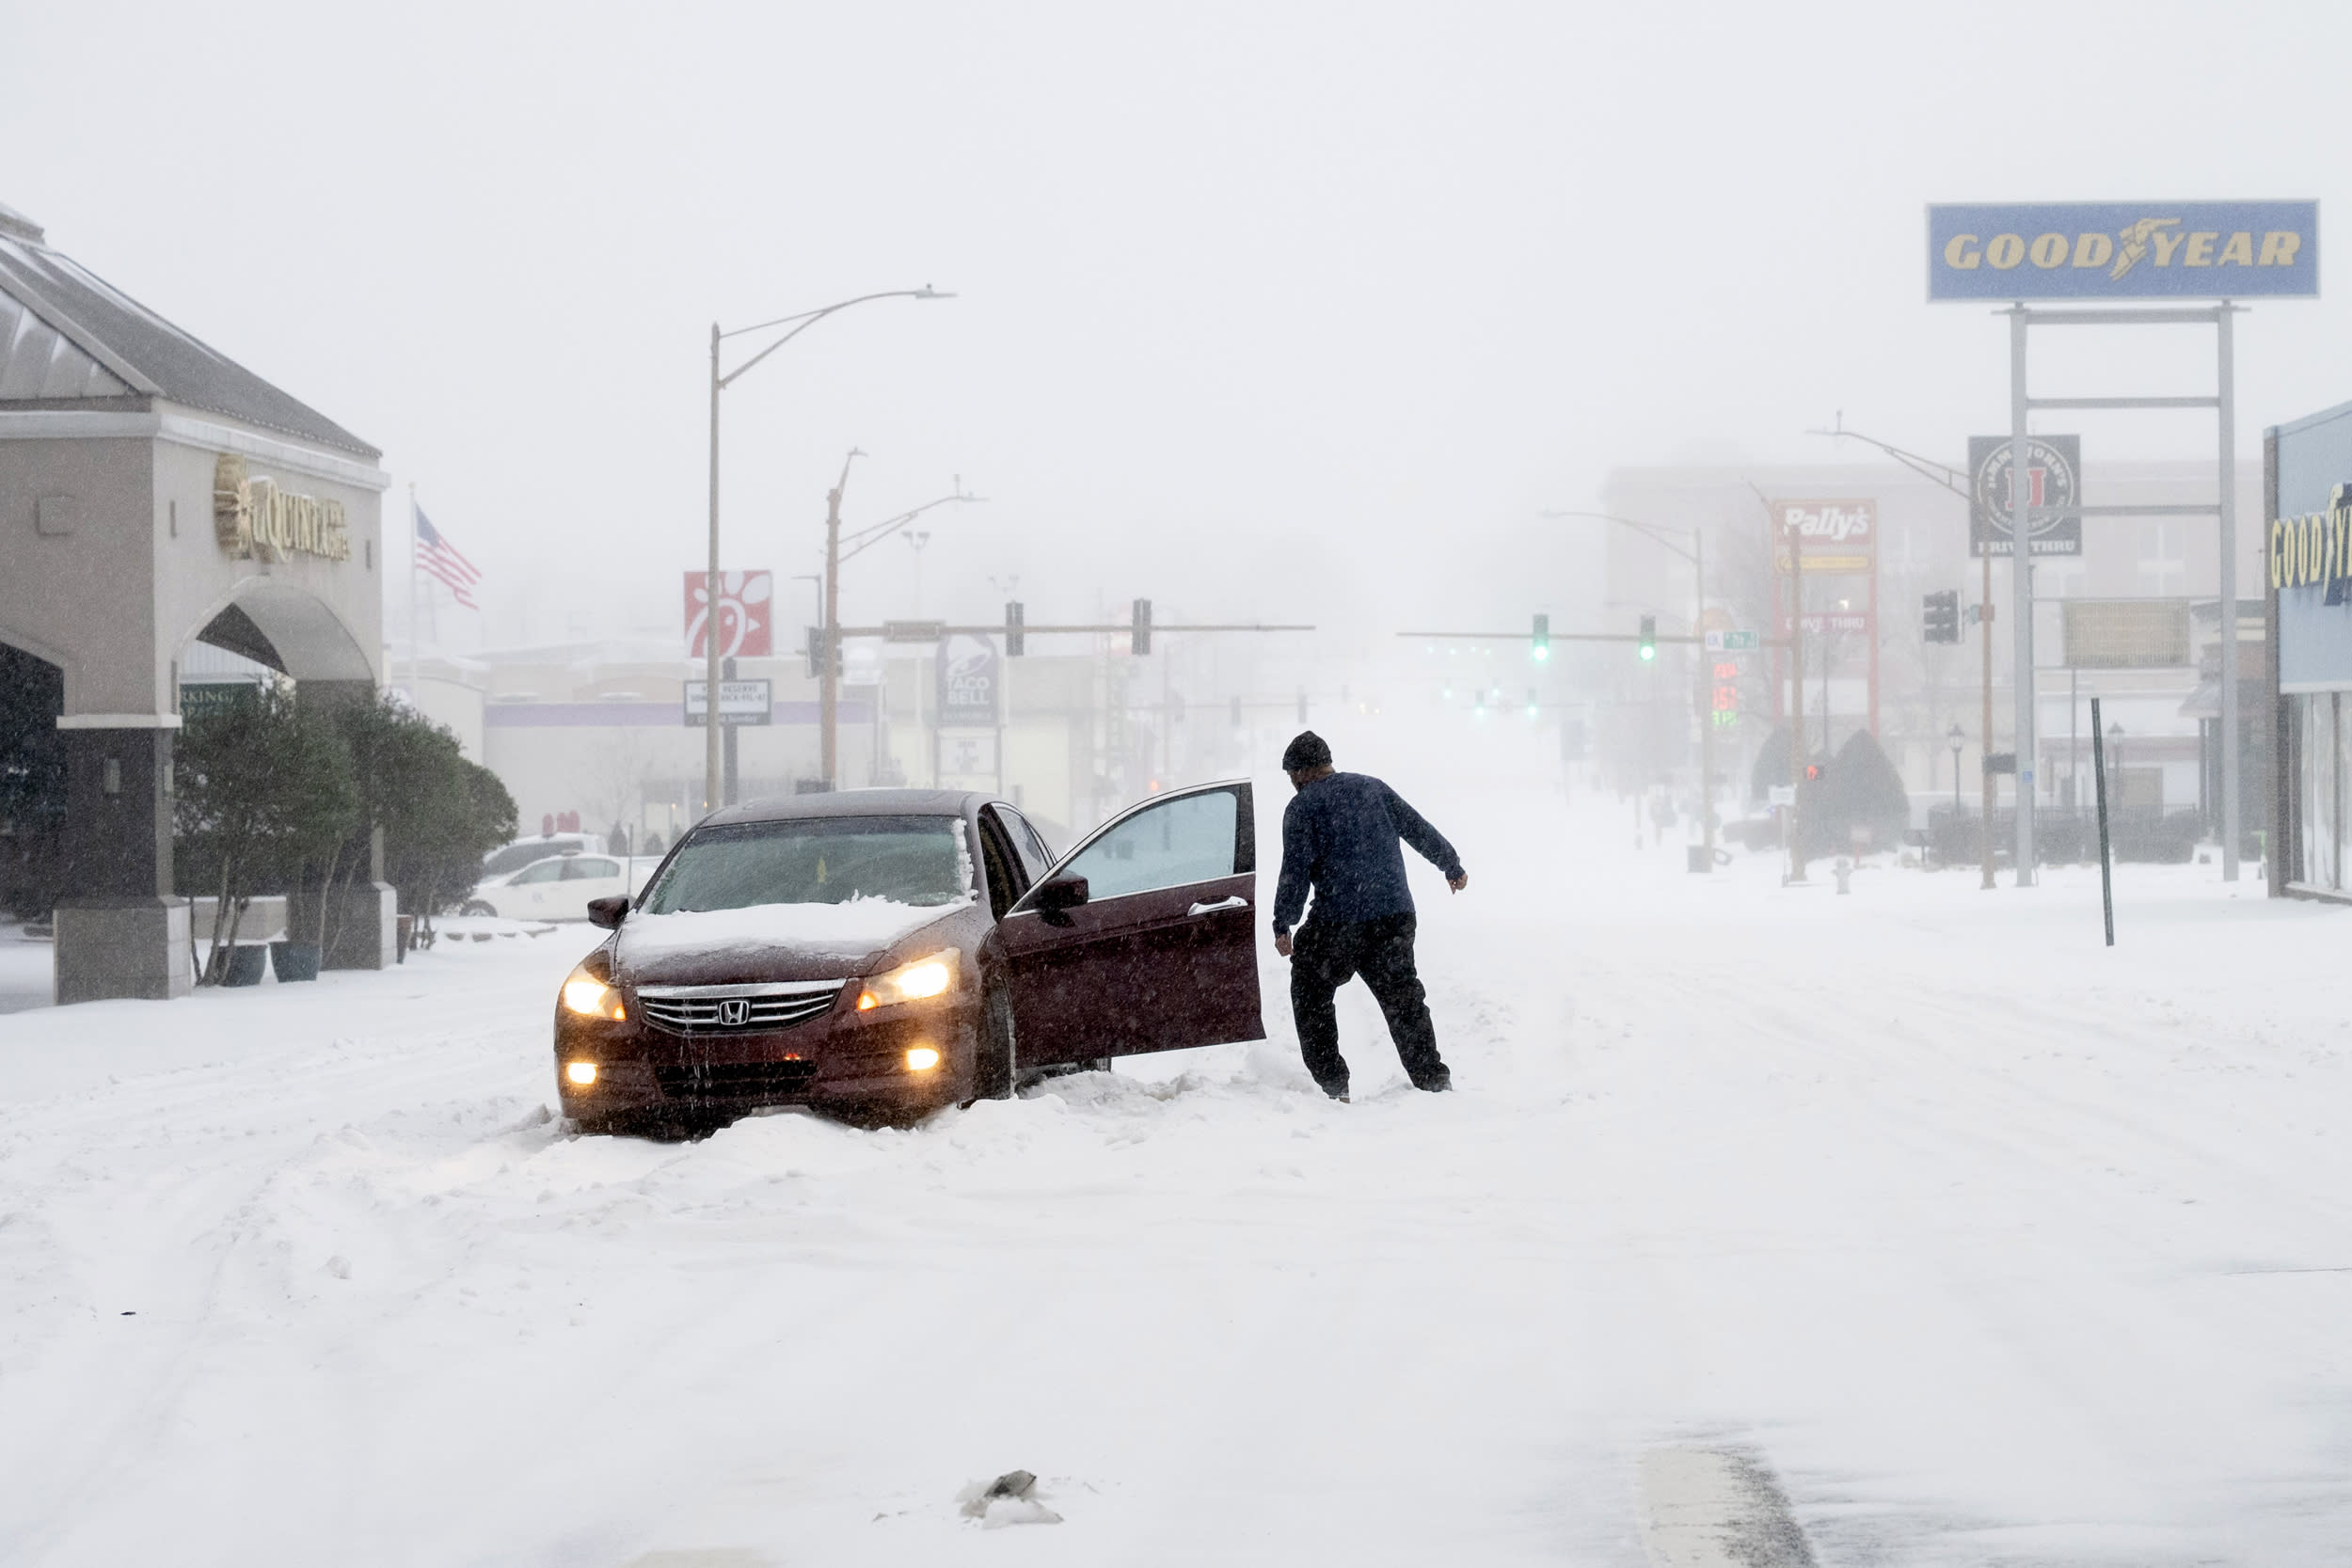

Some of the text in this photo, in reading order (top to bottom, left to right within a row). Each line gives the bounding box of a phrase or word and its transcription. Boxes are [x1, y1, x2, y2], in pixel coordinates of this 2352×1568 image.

[1944, 228, 2302, 273] GOODYEAR
[2030, 540, 2075, 552] THRU
[946, 675, 990, 691] TACO
[947, 690, 990, 705] BELL
